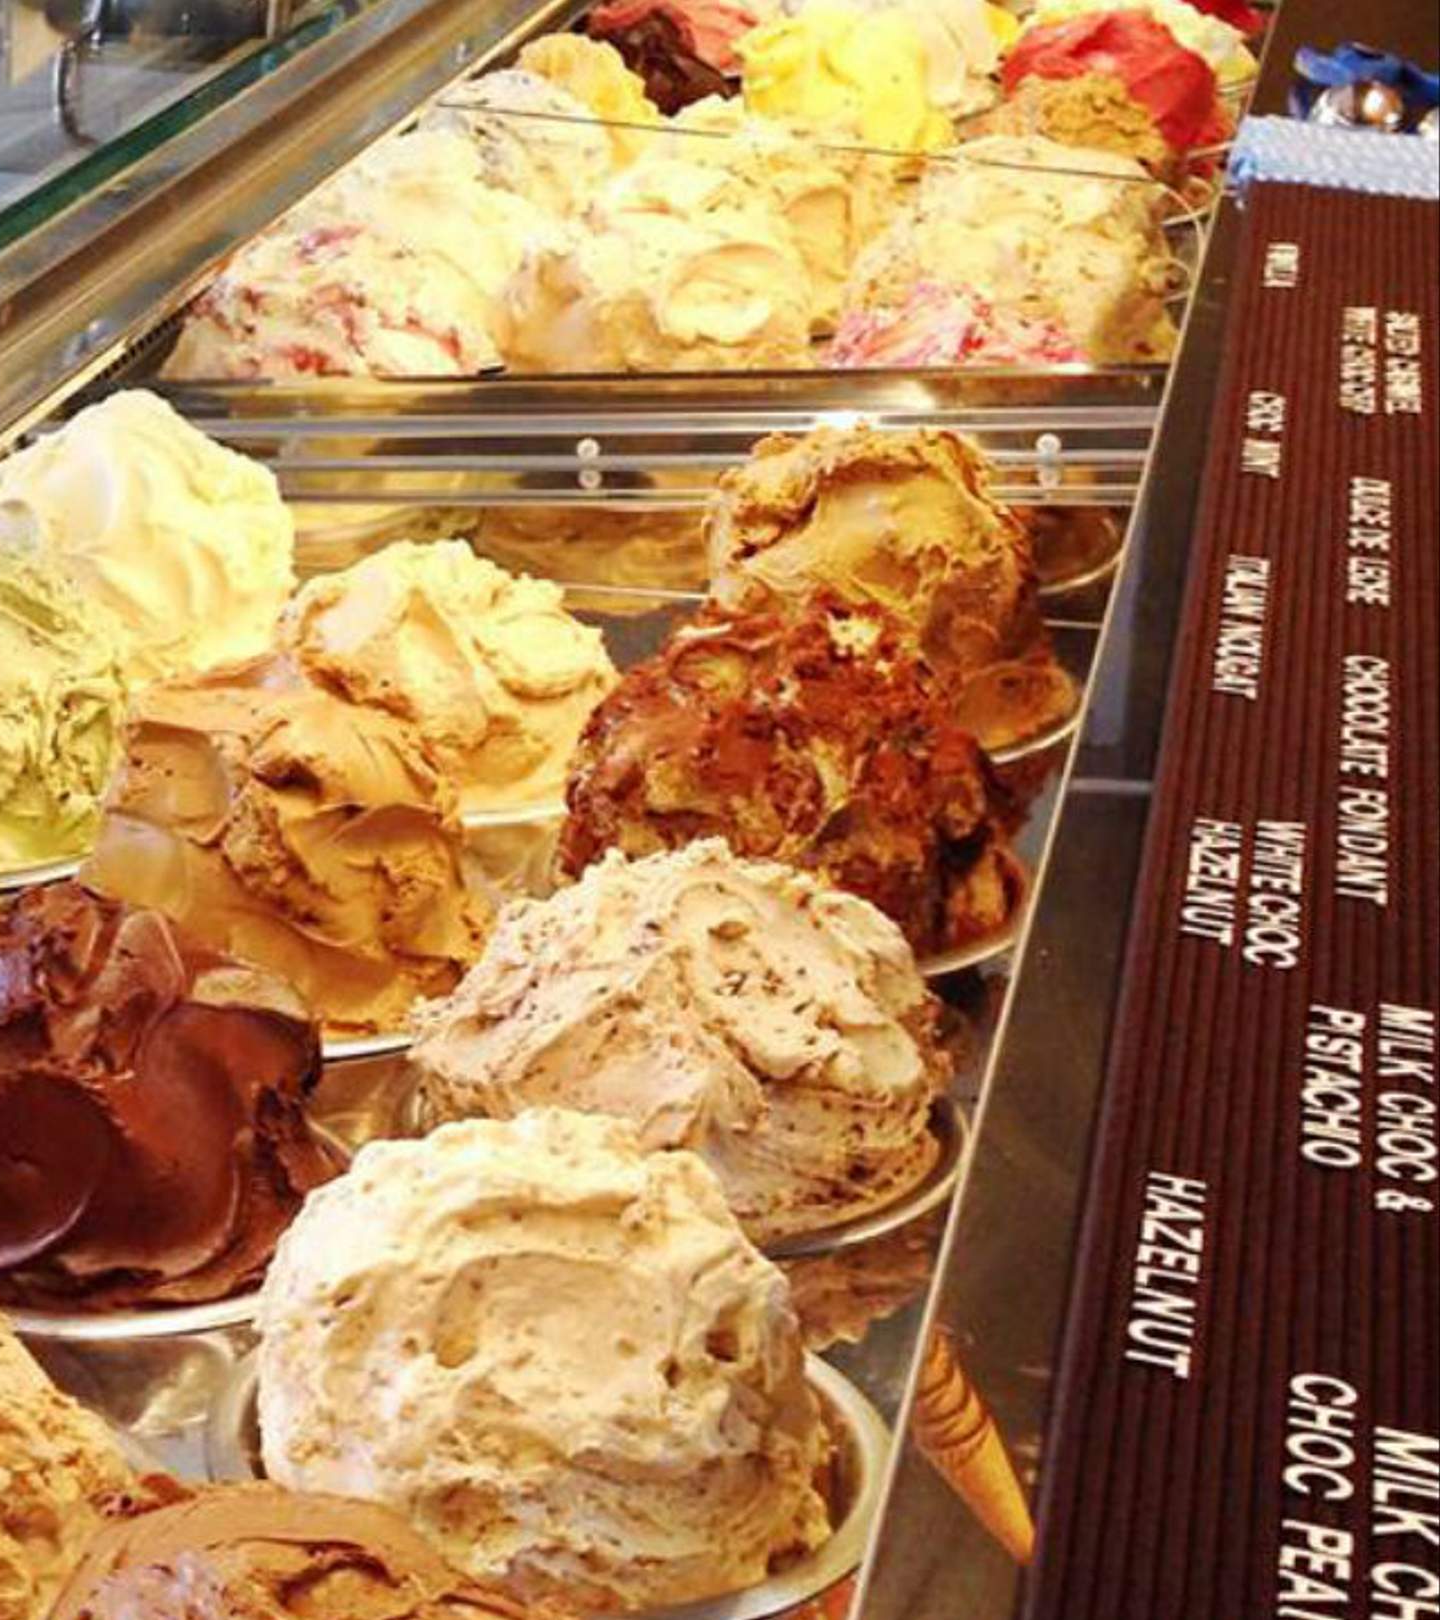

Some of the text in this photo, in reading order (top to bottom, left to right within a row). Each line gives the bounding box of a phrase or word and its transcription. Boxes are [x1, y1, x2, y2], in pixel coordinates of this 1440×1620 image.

[1246, 391, 1286, 432] CHOC
[1346, 476, 1391, 606] DULCE DE LECHE
[1214, 554, 1271, 700] ITALIAN NOUGAT
[1336, 655, 1390, 905] CHOCOLATE FONDANT
[1181, 818, 1242, 946] HAZELNUT
[1242, 820, 1306, 968] WHITE CHOC
[1301, 1004, 1366, 1167] PISTACHIO
[1375, 1003, 1438, 1212] MILK CHOC &
[1125, 1172, 1207, 1379] HAZELNUT
[1283, 1373, 1358, 1500] CHOC
[1372, 1426, 1440, 1546] MILK
